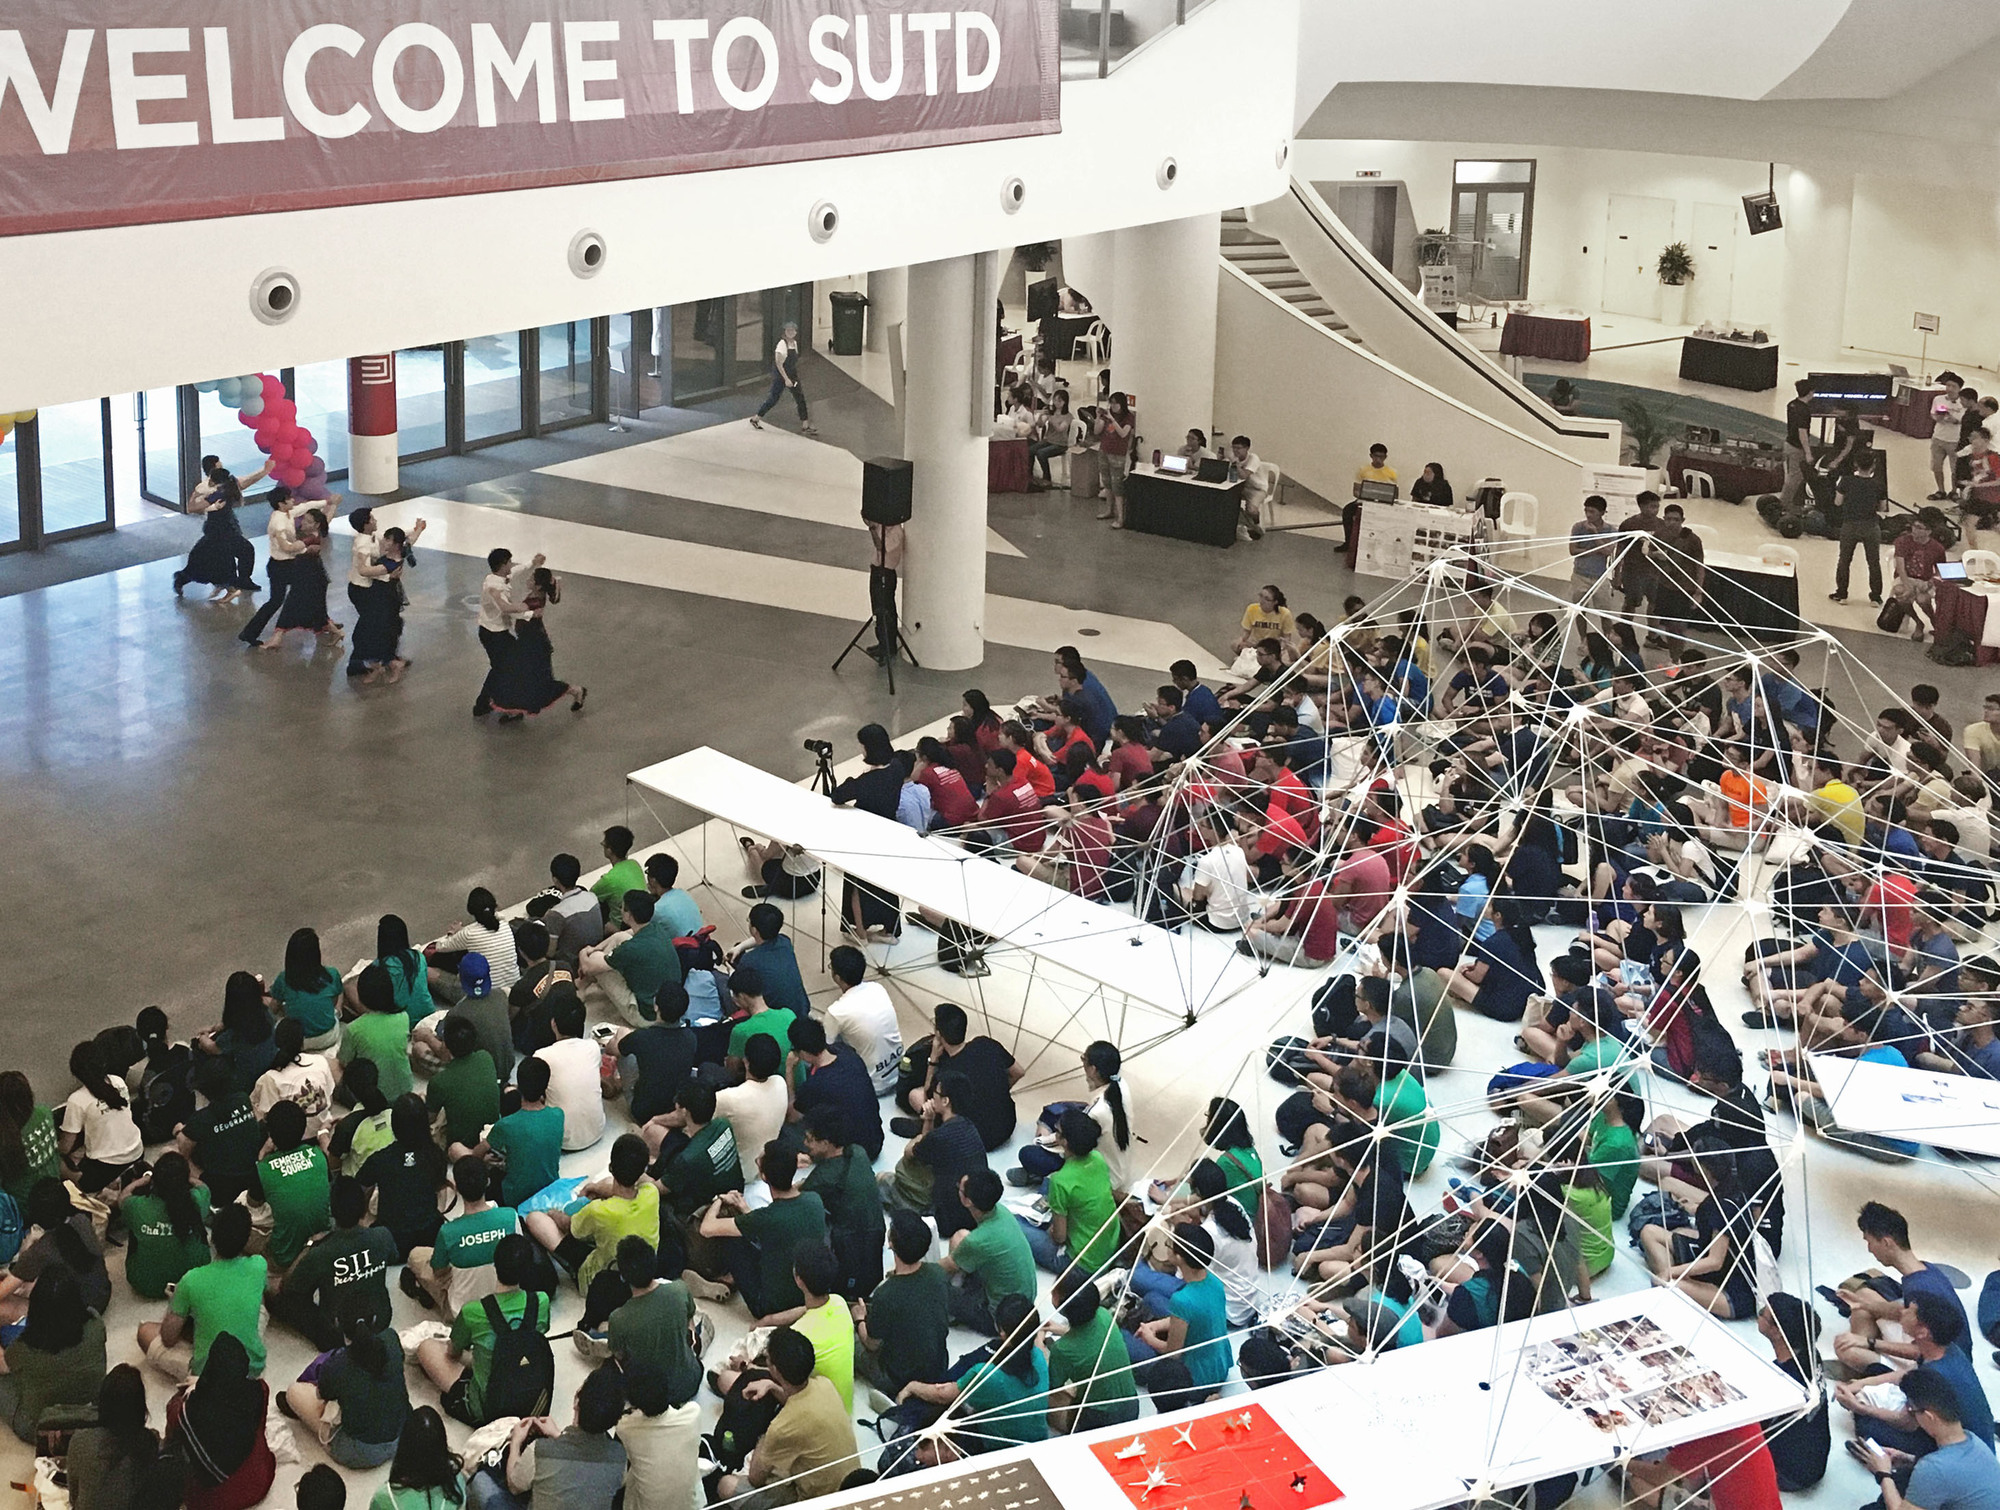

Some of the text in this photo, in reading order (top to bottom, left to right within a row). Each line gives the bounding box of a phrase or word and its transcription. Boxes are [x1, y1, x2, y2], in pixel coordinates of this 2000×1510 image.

[0, 10, 1001, 156] WELCOME TO SUTD
[268, 1151, 306, 1170] TEMASEK
[280, 1158, 314, 1177] SQUASH
[459, 1228, 506, 1248] JOSEPH
[333, 1249, 372, 1278] SJI
